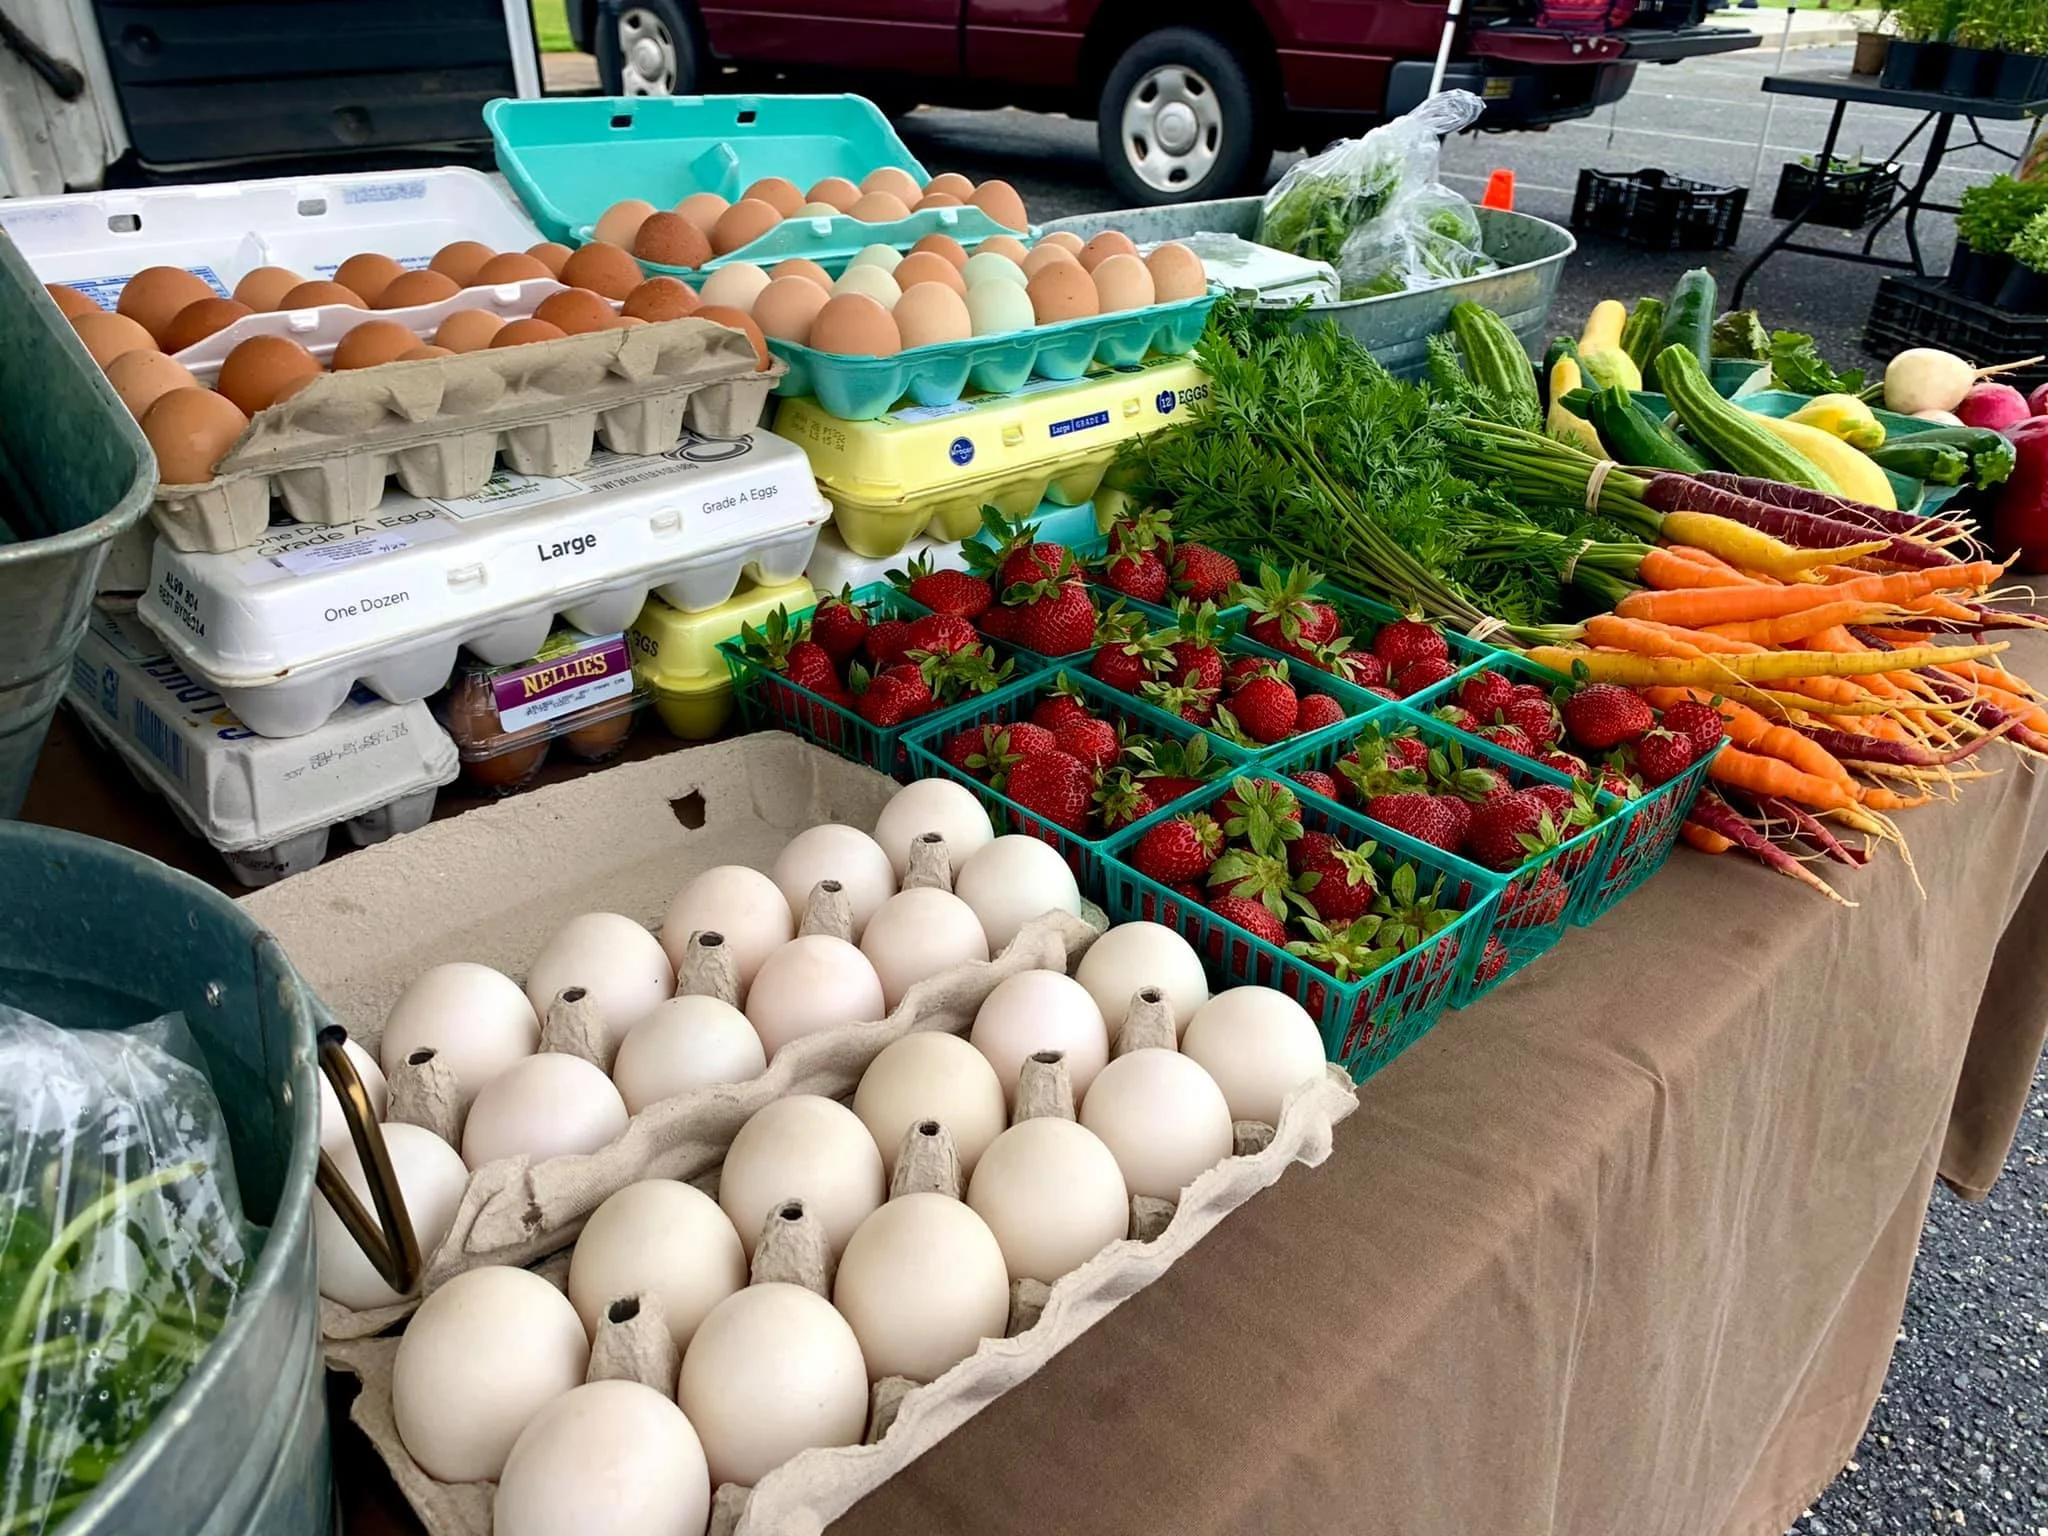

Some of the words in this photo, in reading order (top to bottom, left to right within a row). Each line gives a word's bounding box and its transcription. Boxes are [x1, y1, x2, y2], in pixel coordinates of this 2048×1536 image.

[1178, 384, 1208, 405] EGGS
[1052, 423, 1071, 436] Large
[1075, 416, 1099, 430] GRADE
[702, 496, 737, 515] Grade
[740, 492, 749, 504] A
[750, 484, 779, 501] Eggs
[257, 532, 345, 557] Grade
[354, 525, 377, 536] A
[537, 532, 597, 562] Large
[324, 606, 357, 623] One
[361, 590, 410, 613] Dozen
[522, 653, 608, 698] NELLIES
